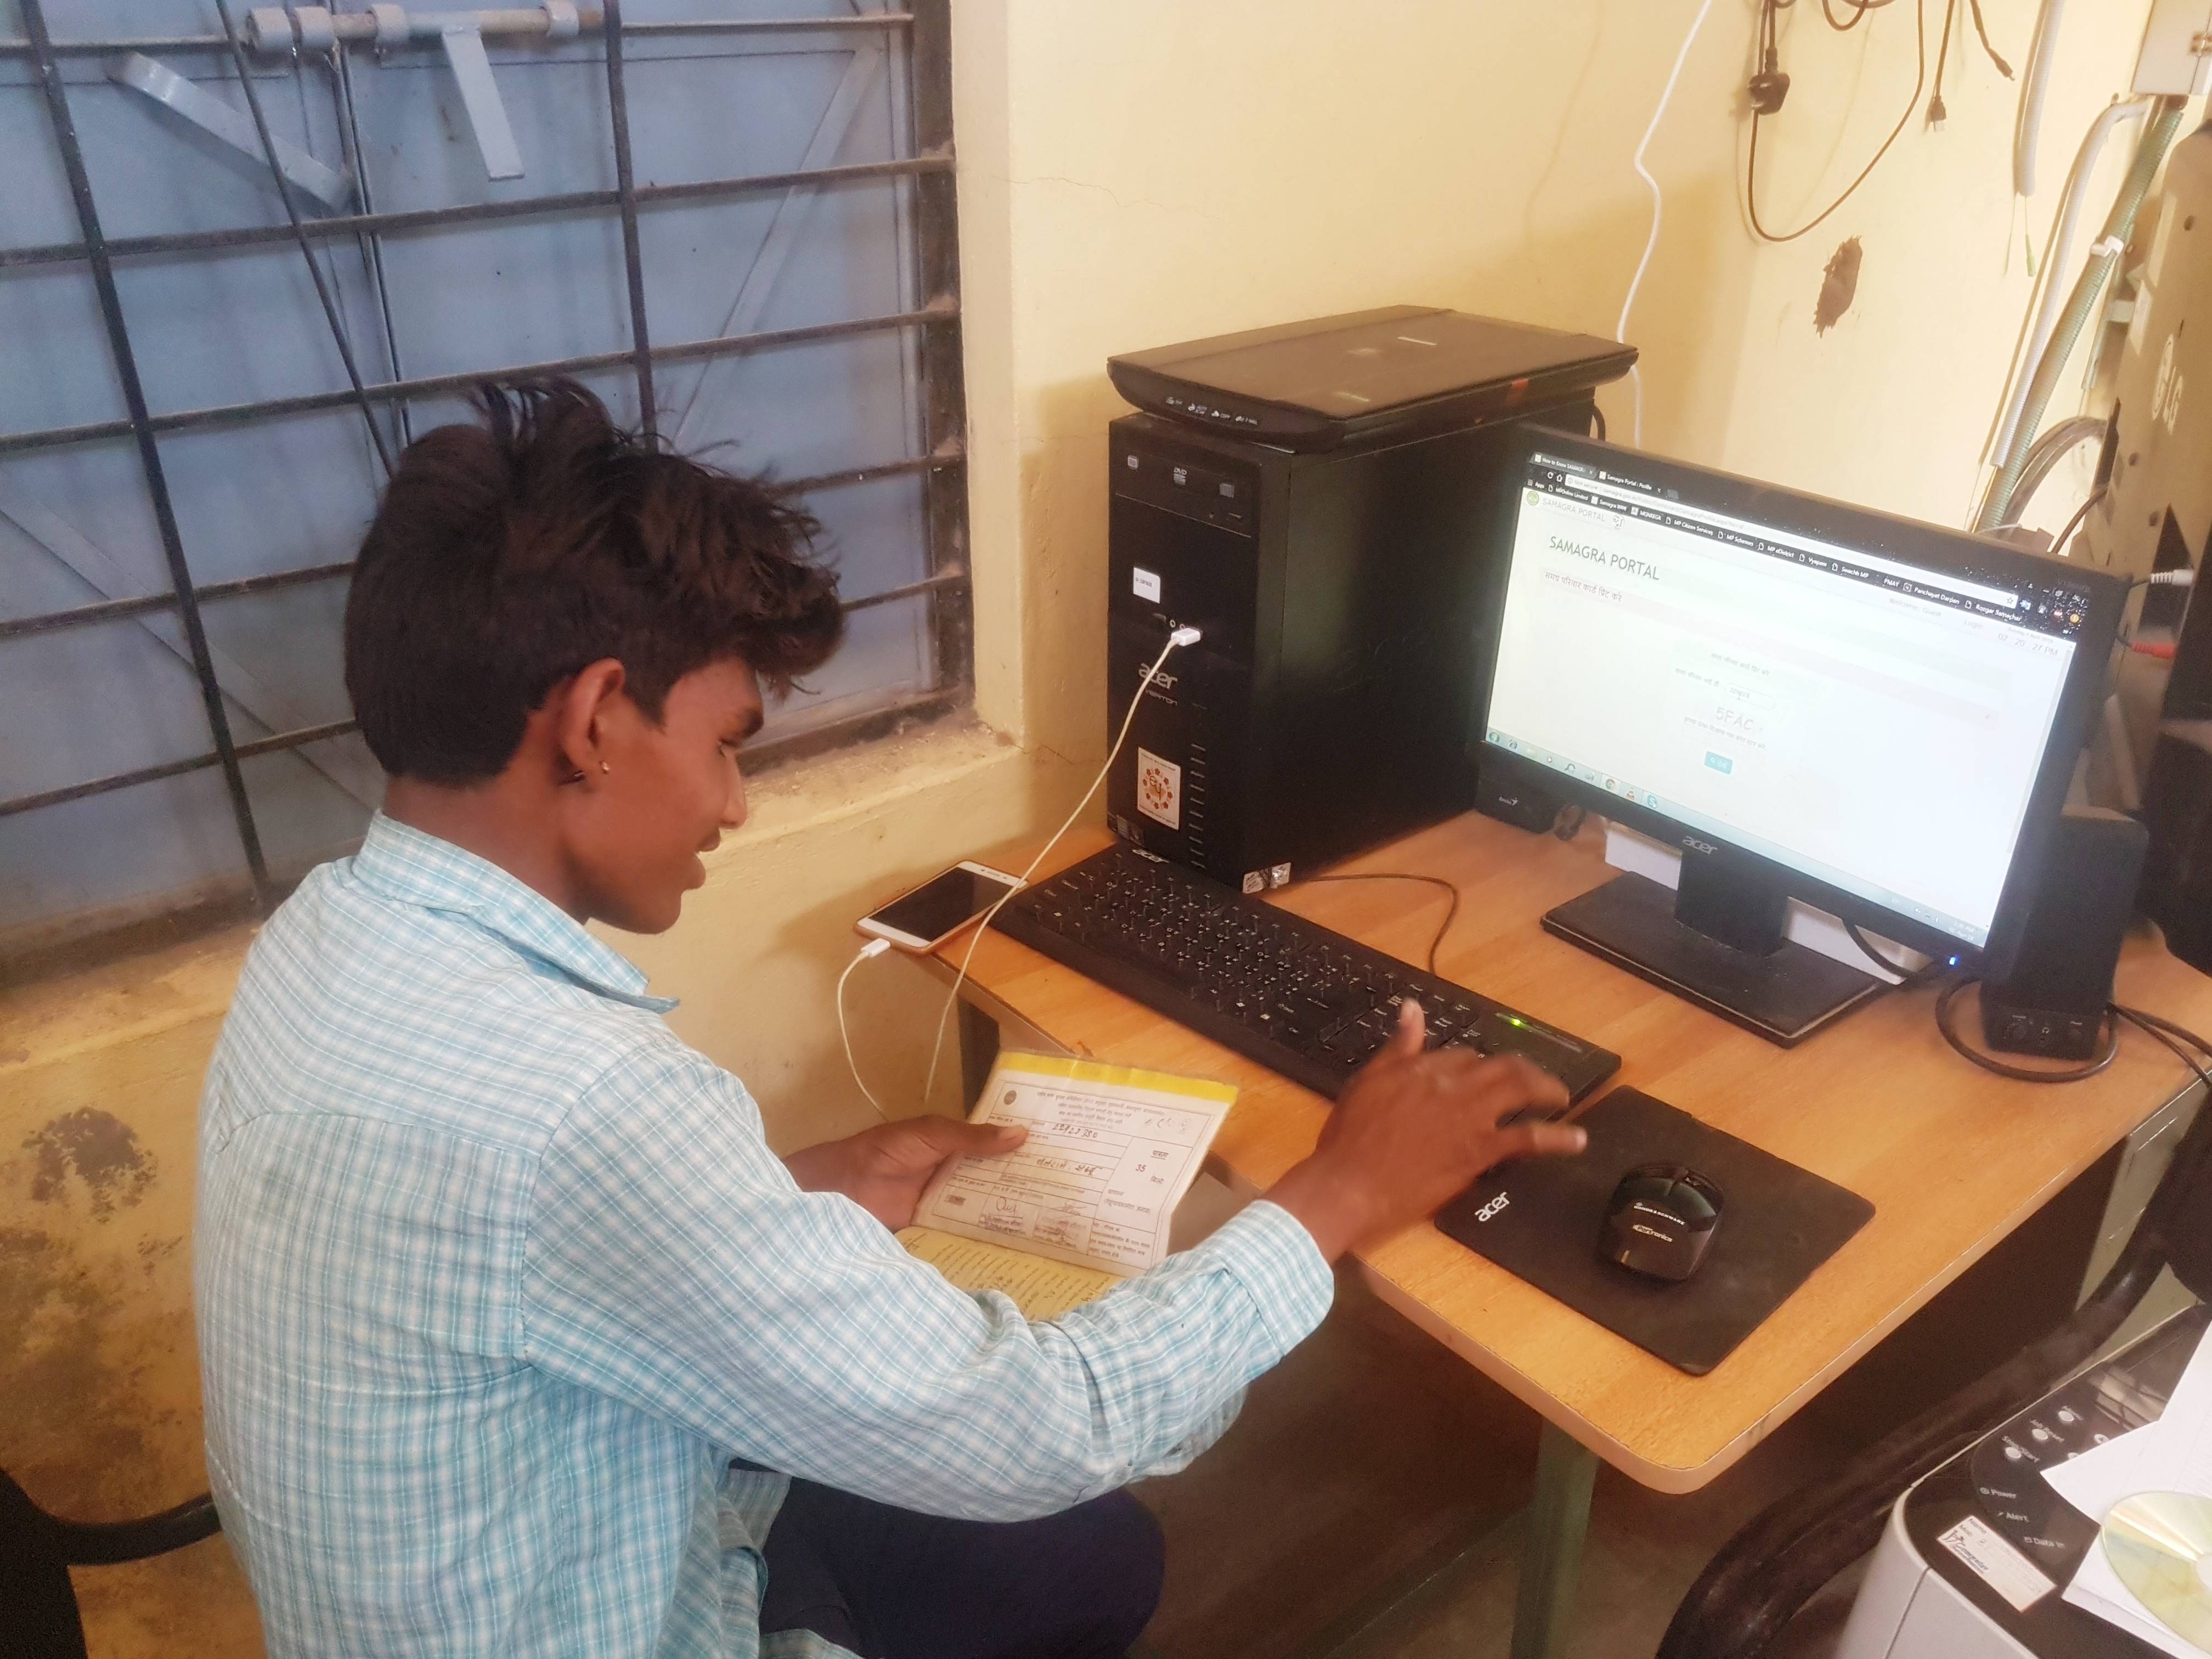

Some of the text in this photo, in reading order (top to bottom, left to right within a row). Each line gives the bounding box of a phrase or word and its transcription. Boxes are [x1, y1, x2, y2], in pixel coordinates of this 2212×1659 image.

[1607, 474, 1624, 483] Samagra
[1542, 498, 1576, 514] SAMAGRA
[1578, 507, 1605, 522] PORTAL
[1550, 536, 1660, 580] SAMAGRA PORTAL
[1884, 578, 1899, 588] PMAY
[1914, 587, 1940, 599] Panchayat
[1976, 604, 1994, 614] Rozgar
[1682, 836, 1718, 855] acer
[1475, 1192, 1510, 1222] acer
[1991, 1489, 2017, 1499] Power
[2006, 1513, 2029, 1522] Alert
[2033, 1538, 2055, 1547] Data
